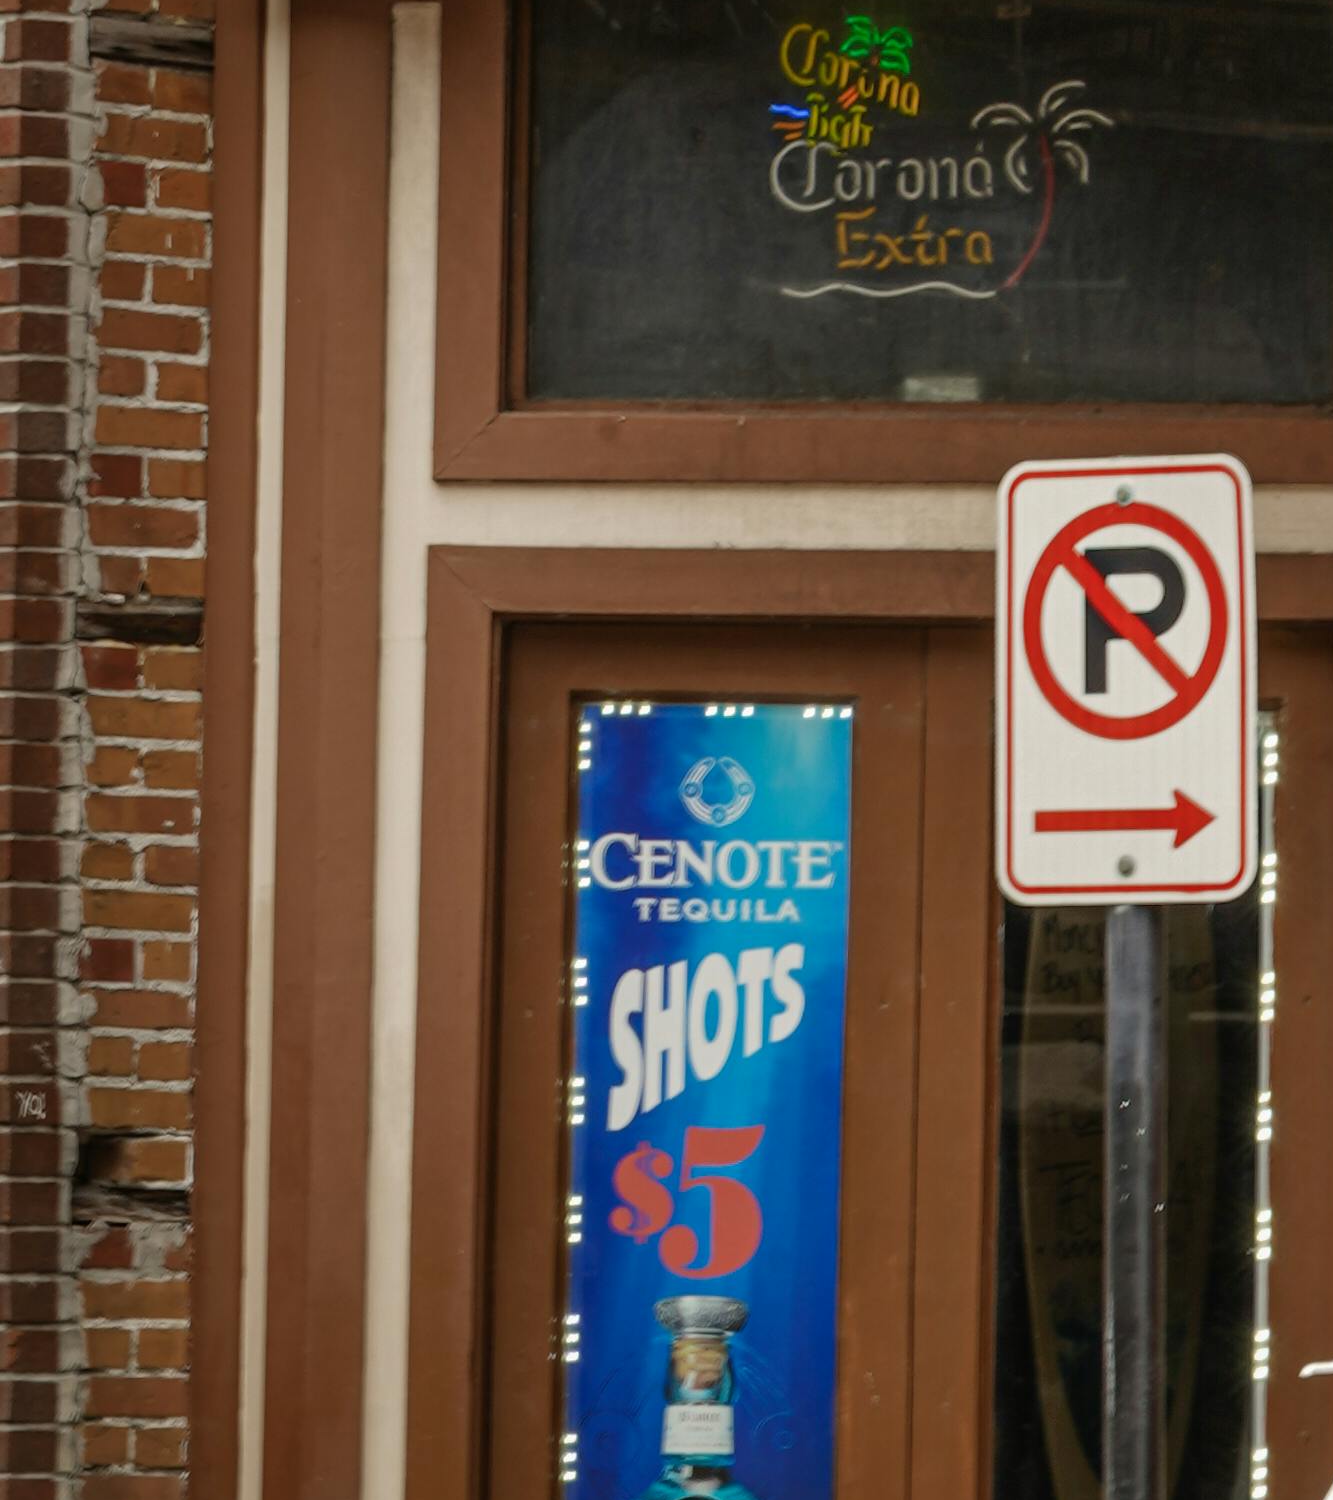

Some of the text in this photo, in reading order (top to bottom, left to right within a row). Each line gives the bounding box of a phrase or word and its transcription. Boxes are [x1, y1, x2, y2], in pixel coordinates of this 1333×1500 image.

[769, 139, 994, 213] Corona
[834, 206, 994, 271] Extra
[589, 832, 838, 891] CENOTE
[632, 897, 801, 923] TEQUILA
[606, 942, 806, 1132] SHOTS
[609, 1124, 767, 1280] $5
